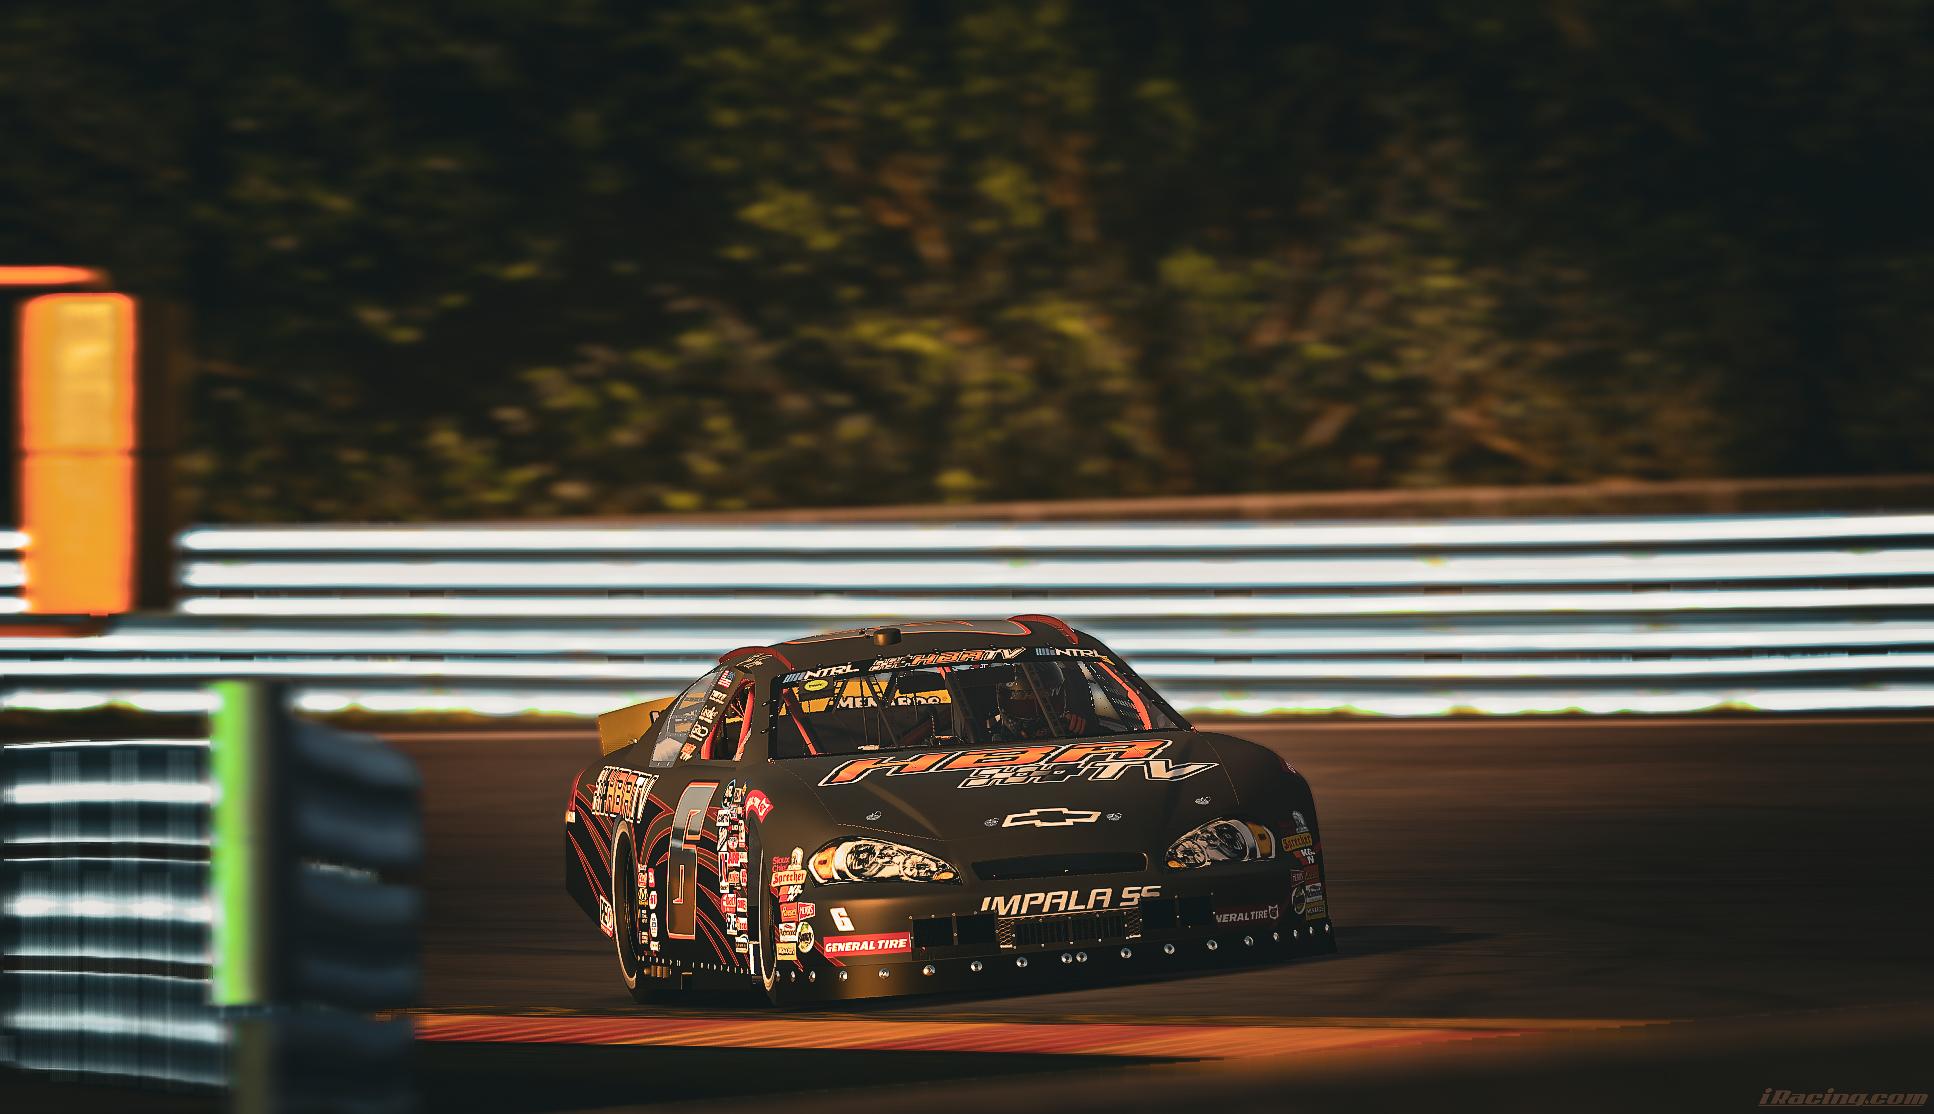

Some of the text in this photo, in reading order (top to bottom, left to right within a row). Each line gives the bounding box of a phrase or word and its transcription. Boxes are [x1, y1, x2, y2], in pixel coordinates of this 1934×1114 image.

[1055, 648, 1104, 658] NTRL
[804, 663, 860, 680] NTRL
[818, 739, 1173, 787] HBR
[1088, 759, 1220, 782] TV
[980, 887, 1113, 916] IMPALA
[829, 907, 855, 932] 6
[1250, 909, 1268, 920] TIRE
[825, 938, 908, 953] GENERAL TIRE
